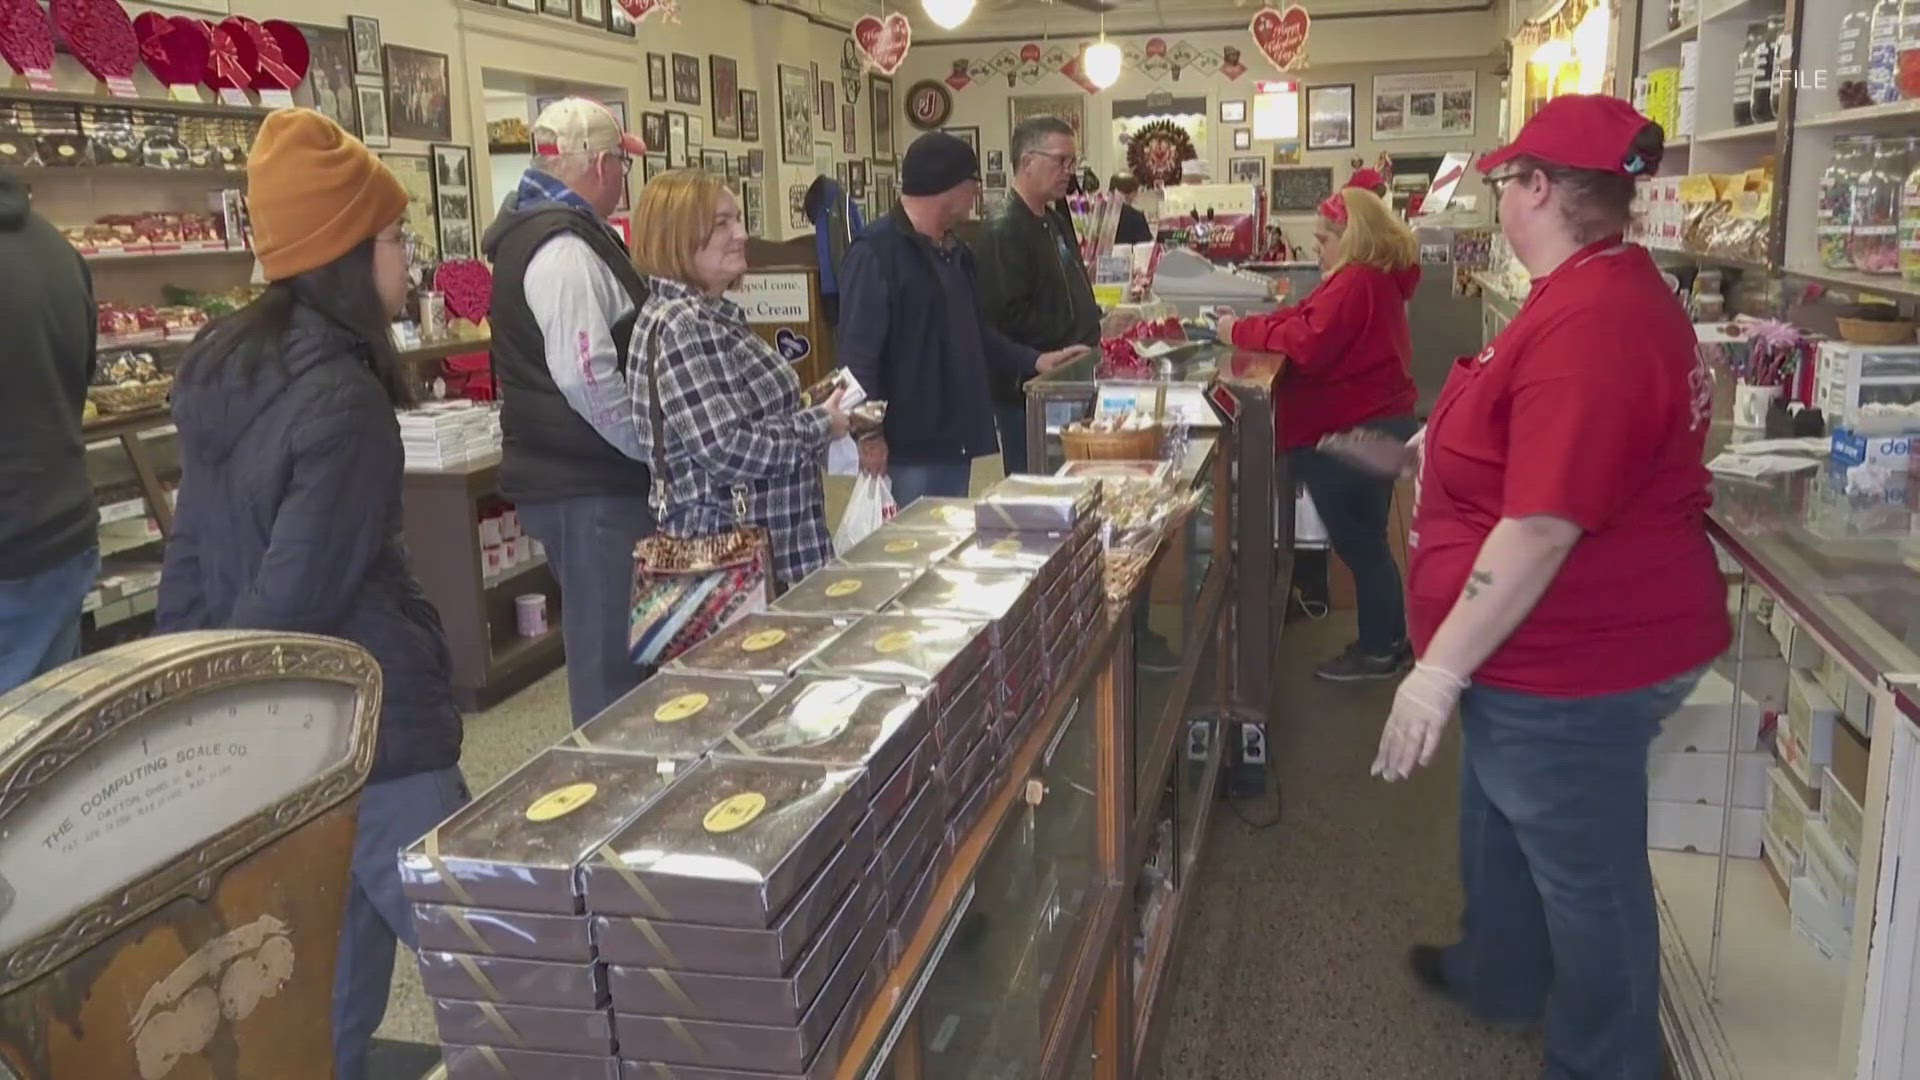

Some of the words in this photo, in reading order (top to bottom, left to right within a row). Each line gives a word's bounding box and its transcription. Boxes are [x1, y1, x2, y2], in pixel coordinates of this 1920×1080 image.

[757, 301, 802, 316] Cream
[303, 713, 313, 730] 2
[42, 817, 74, 850] THE
[80, 757, 169, 817] COMPUTING
[175, 743, 222, 764] SCALE
